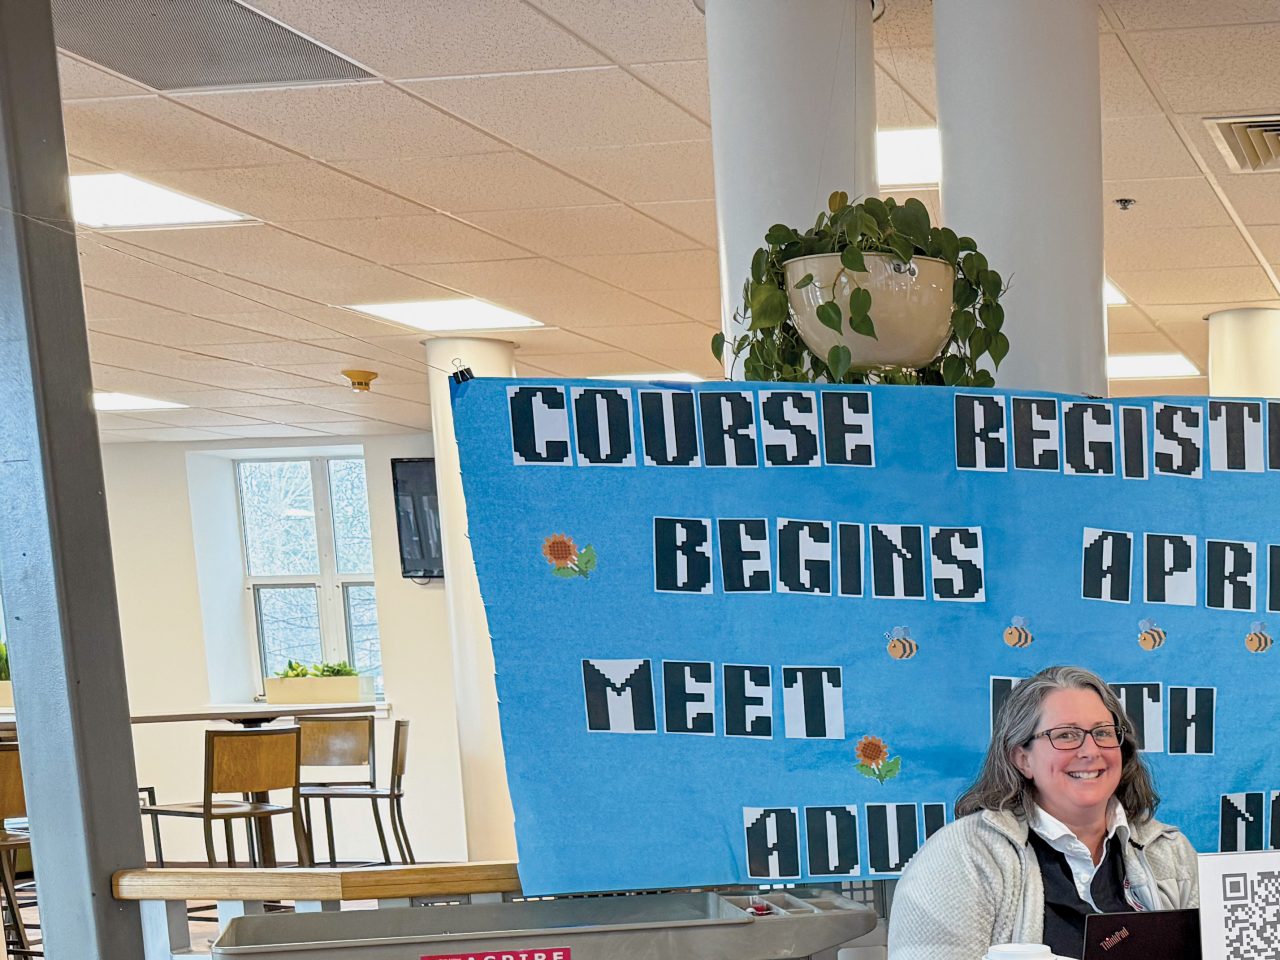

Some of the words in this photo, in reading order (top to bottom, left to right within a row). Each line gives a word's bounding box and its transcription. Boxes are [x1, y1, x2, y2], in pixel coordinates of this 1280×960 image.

[510, 387, 873, 466] COURSE
[655, 518, 984, 600] BEGINS
[582, 660, 842, 738] MEET
[1100, 926, 1129, 951] ThinkPad
